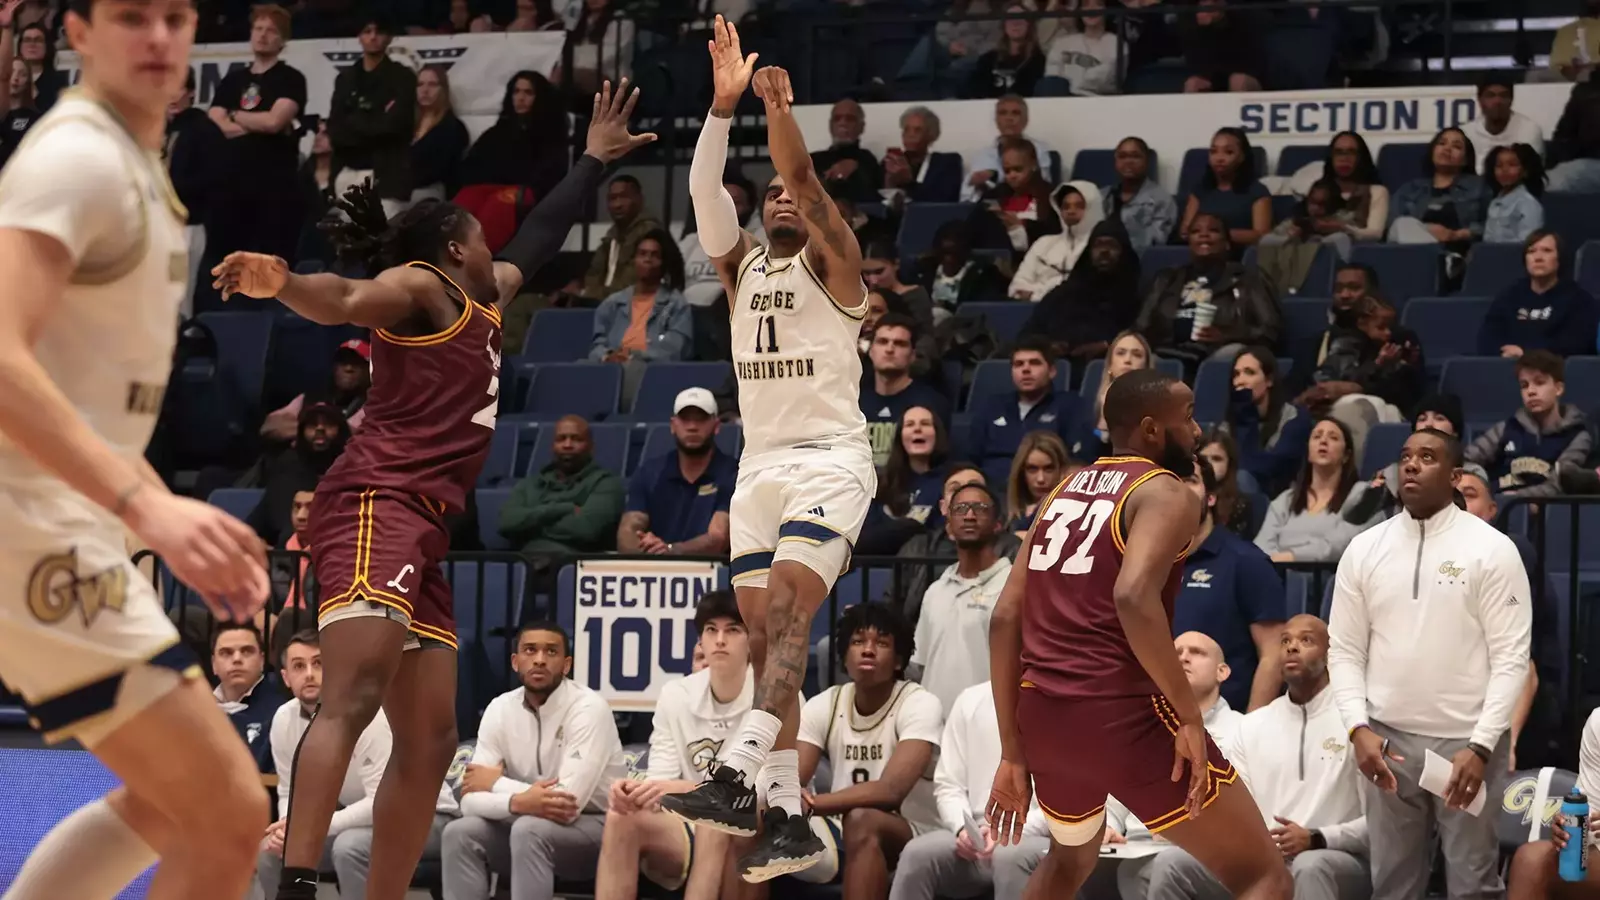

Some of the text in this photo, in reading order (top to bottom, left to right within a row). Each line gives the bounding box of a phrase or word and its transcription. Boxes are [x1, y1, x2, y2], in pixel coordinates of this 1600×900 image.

[1240, 100, 1419, 133] SECTION
[755, 315, 779, 353] 11
[1028, 498, 1115, 575] 32
[26, 545, 130, 630] GW
[579, 576, 713, 608] SECTION
[583, 616, 698, 692] 104
[845, 743, 883, 761] EORGE
